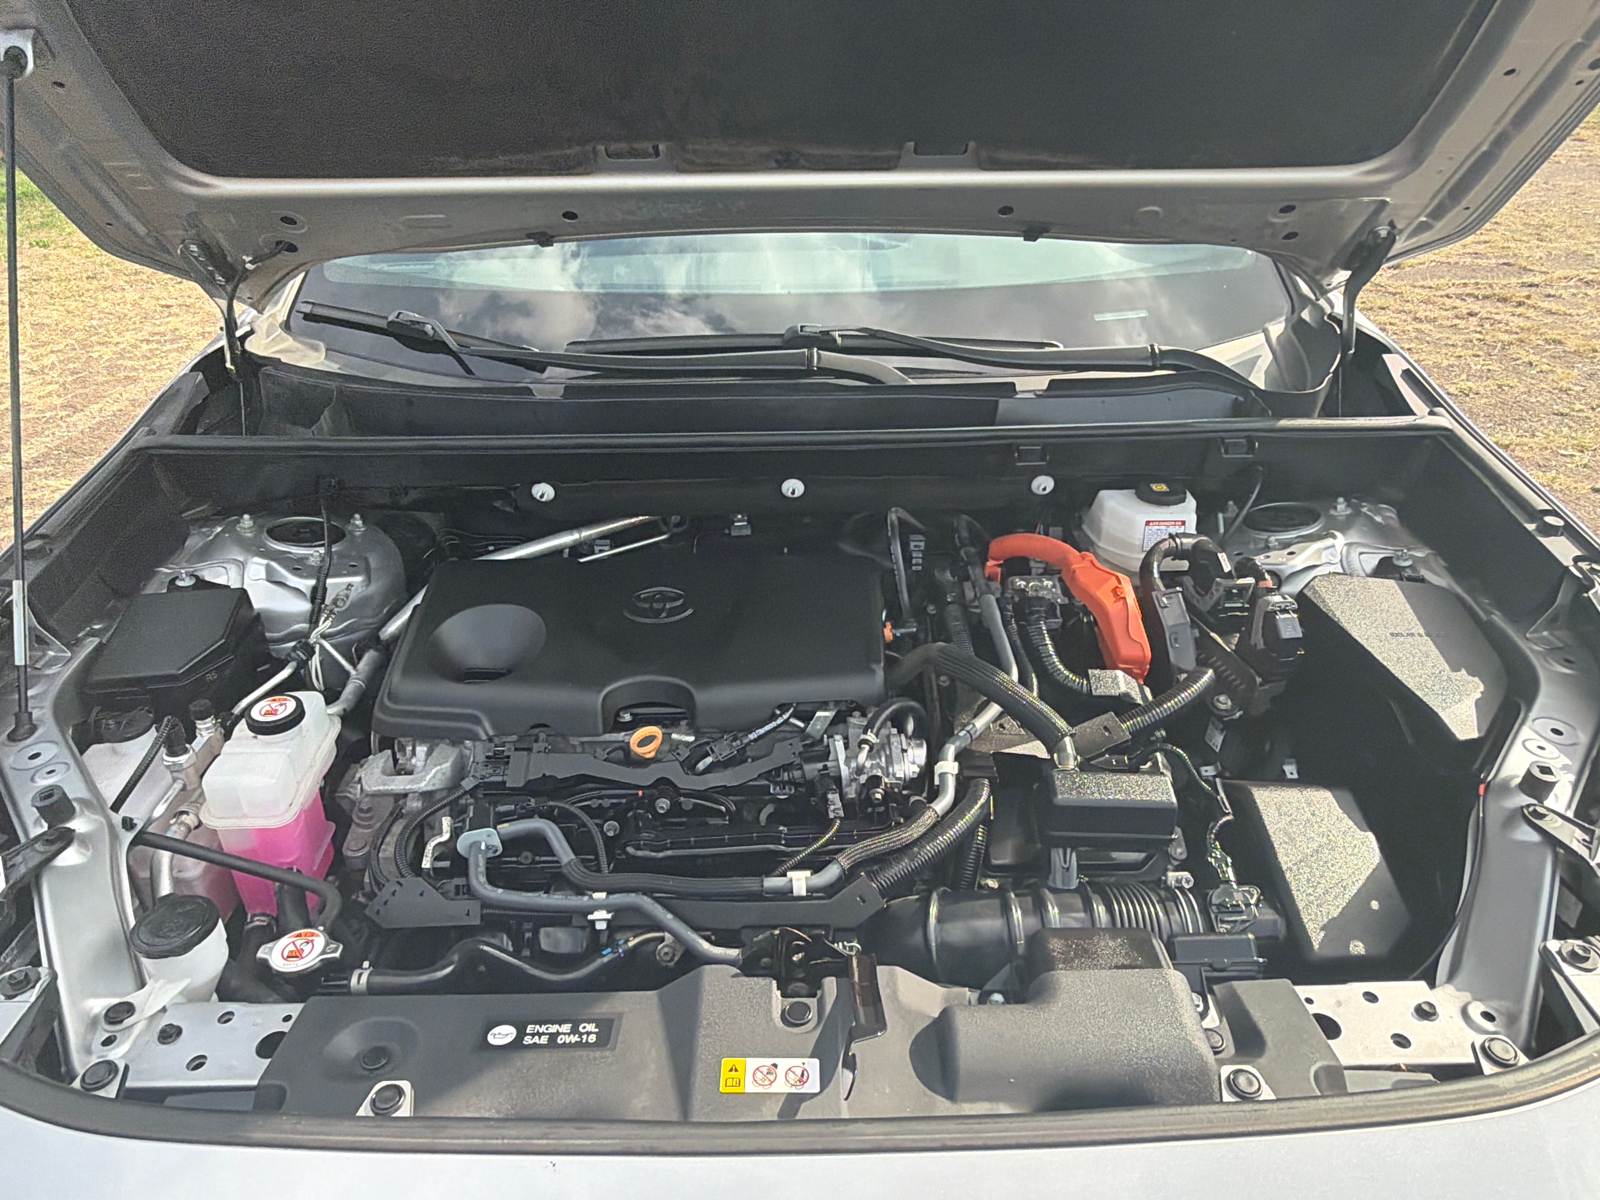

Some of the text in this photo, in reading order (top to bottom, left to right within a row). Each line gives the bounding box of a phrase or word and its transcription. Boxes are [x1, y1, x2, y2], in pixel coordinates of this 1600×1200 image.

[525, 1022, 600, 1034] ENGINE OIL
[522, 1033, 597, 1045] SAE 0W-16
